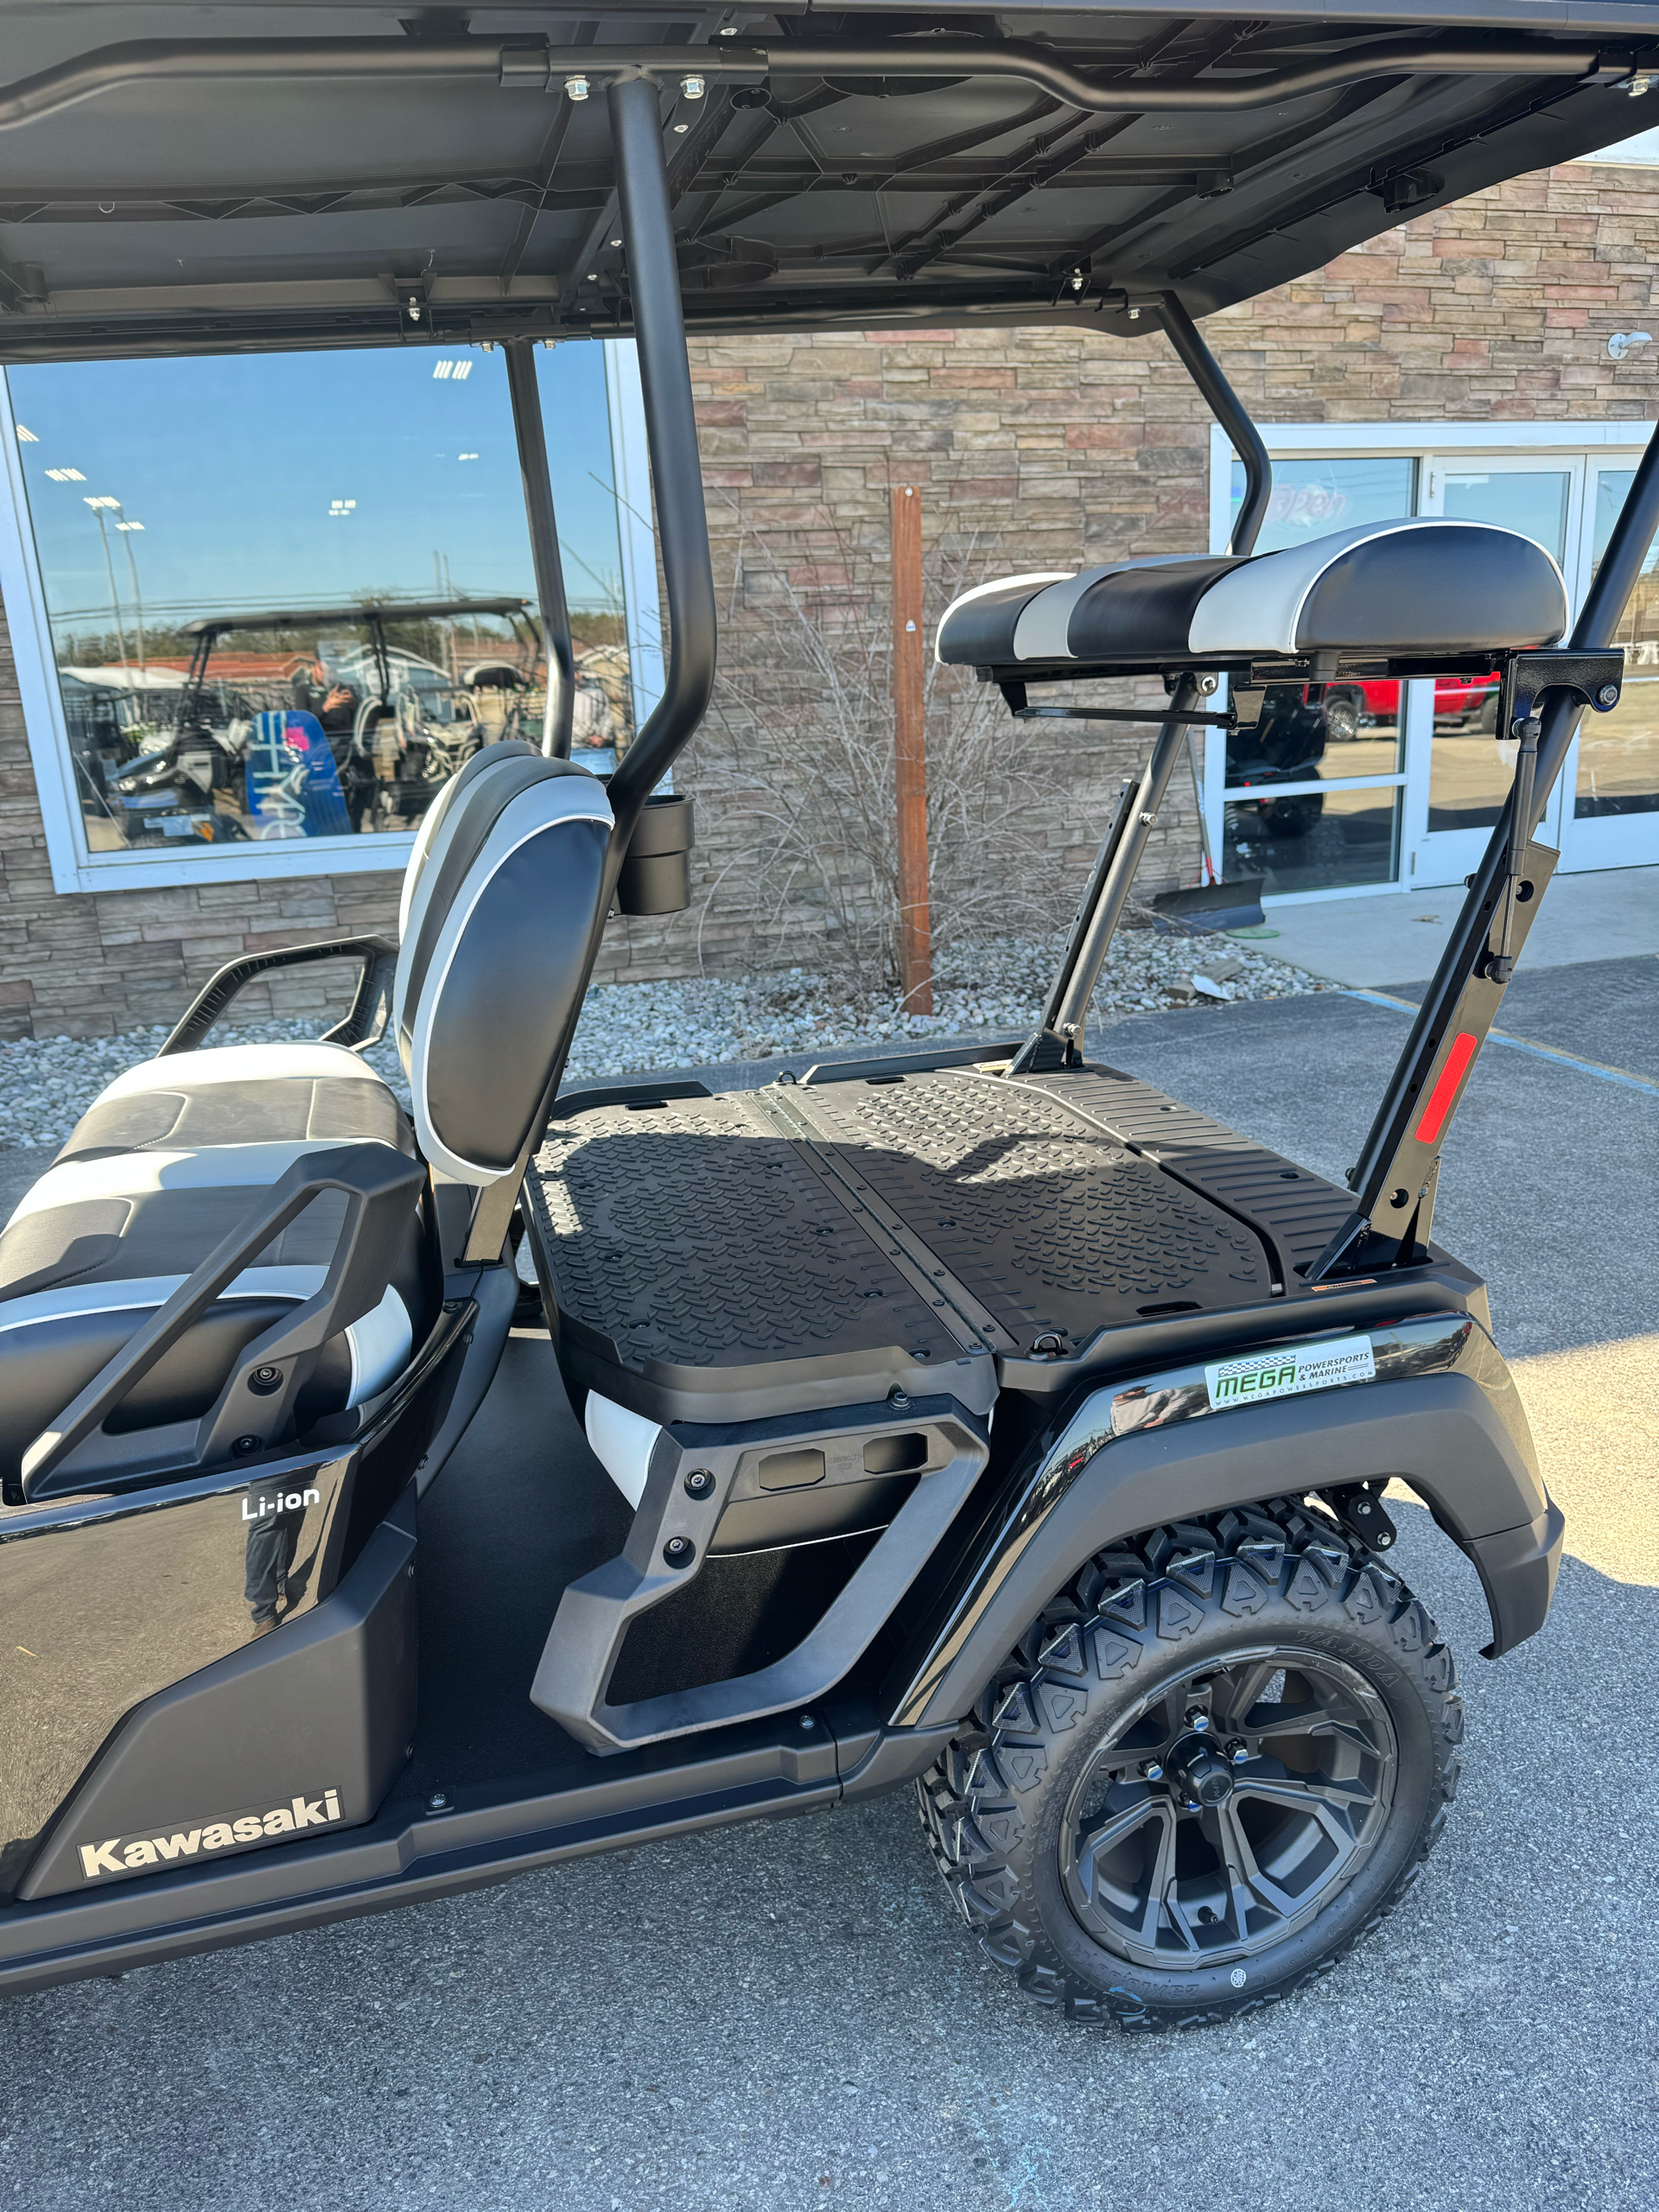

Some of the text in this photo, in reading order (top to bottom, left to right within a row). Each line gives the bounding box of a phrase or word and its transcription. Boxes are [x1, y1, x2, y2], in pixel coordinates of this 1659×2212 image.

[1298, 1352, 1370, 1373] POWERSPORTS
[1309, 1365, 1347, 1380] MARINE
[1215, 1364, 1296, 1399] MEGA
[242, 1488, 320, 1521] Li-ion
[1294, 1630, 1400, 1688] WANDA
[80, 1789, 340, 1878] Kawasaki
